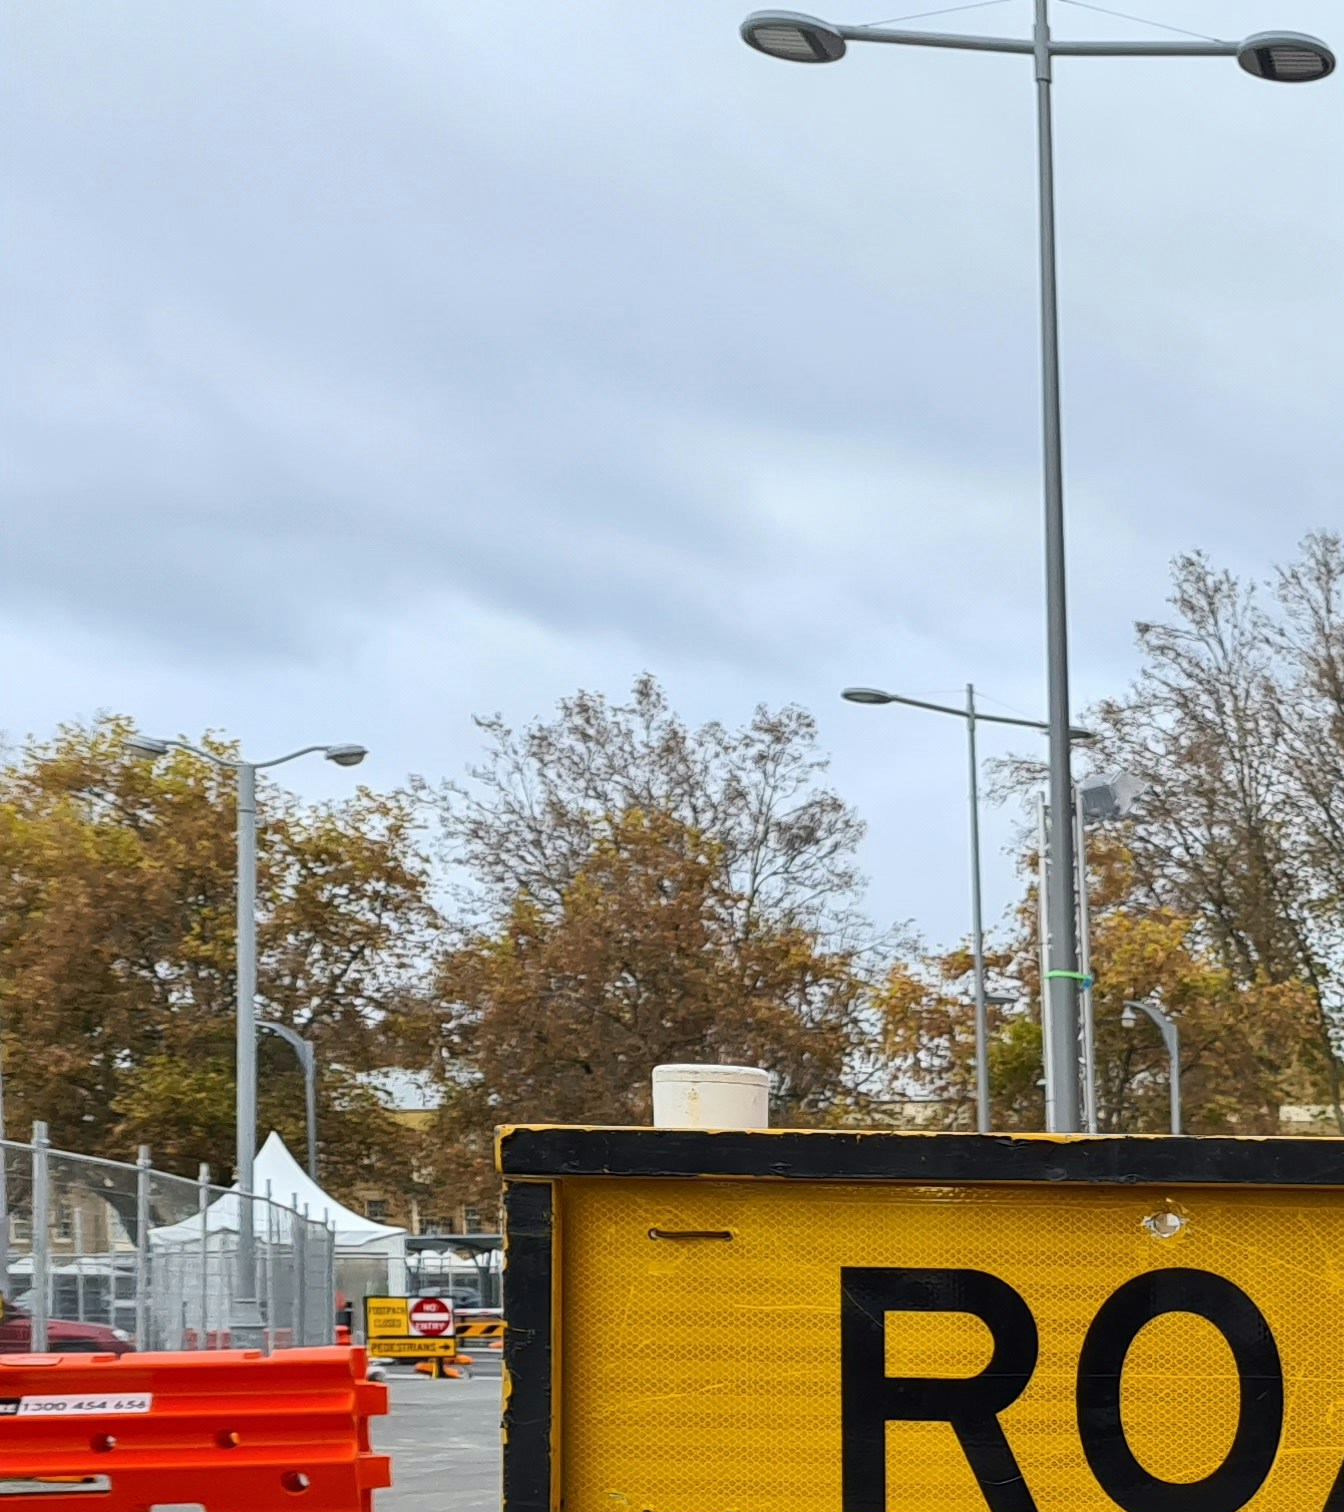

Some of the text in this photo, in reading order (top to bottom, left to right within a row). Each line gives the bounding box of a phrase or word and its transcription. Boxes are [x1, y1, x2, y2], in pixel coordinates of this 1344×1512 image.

[422, 1303, 438, 1311] NO
[415, 1322, 446, 1331] ENTRY
[371, 1342, 437, 1353] PEDESTRIANS
[72, 1400, 107, 1410] 454
[114, 1400, 146, 1409] 656
